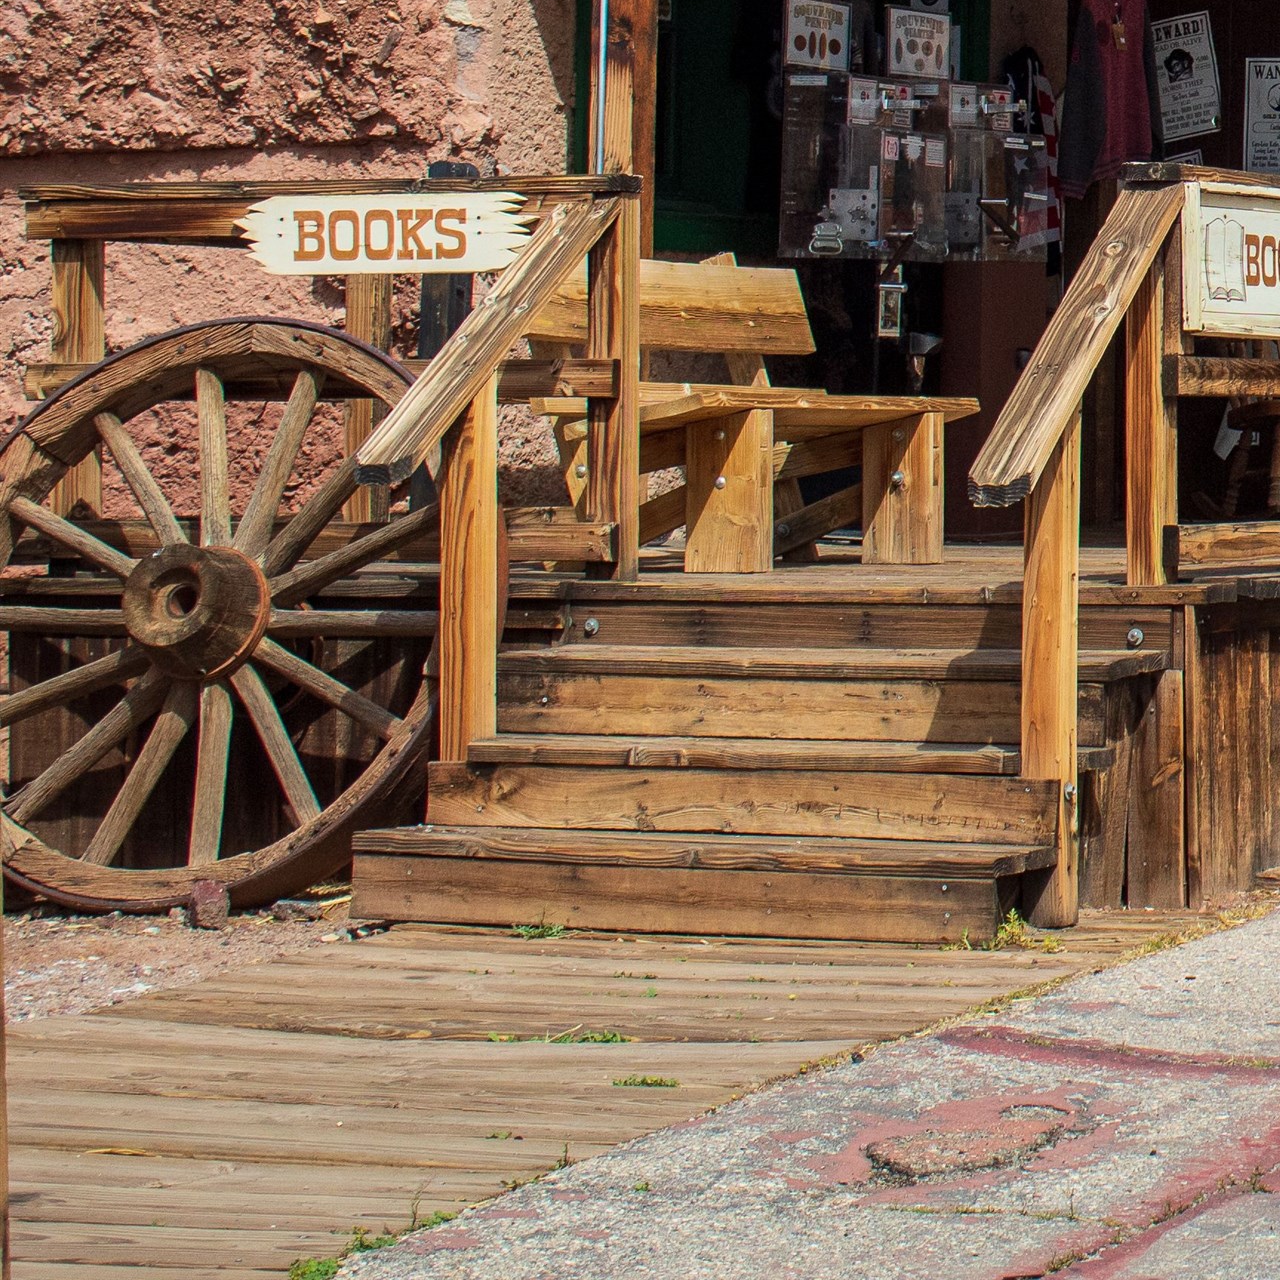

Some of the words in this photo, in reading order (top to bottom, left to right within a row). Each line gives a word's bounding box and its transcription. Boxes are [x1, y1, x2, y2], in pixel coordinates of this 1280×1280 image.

[1154, 18, 1205, 42] EWARD!
[1154, 43, 1170, 53] EAD
[293, 207, 467, 262] BOOKS
